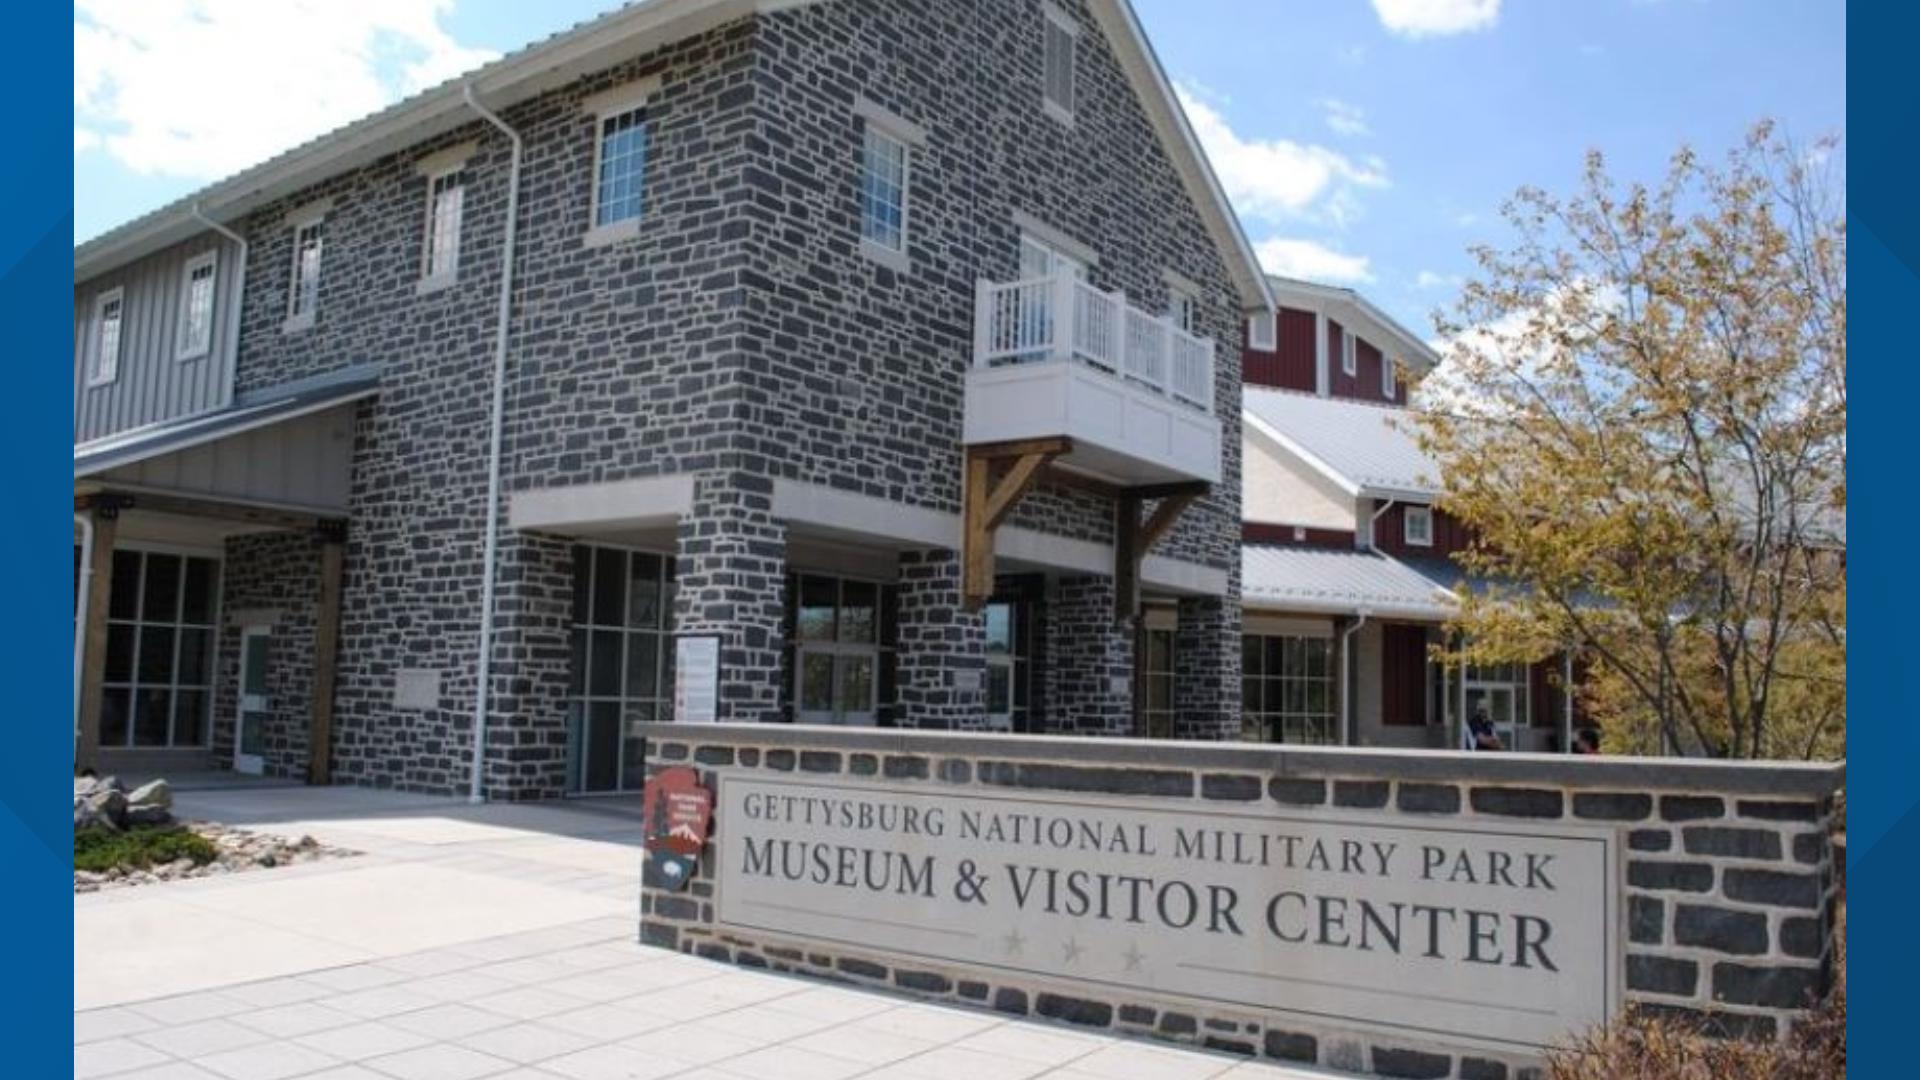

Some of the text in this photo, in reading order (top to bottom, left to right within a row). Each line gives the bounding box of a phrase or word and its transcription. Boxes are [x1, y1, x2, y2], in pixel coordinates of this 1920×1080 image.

[743, 793, 1557, 891] GETTYSBURG NATIONAL MILITARY PARK
[742, 836, 1560, 973] MUSEUM & VISITOR CENTER
